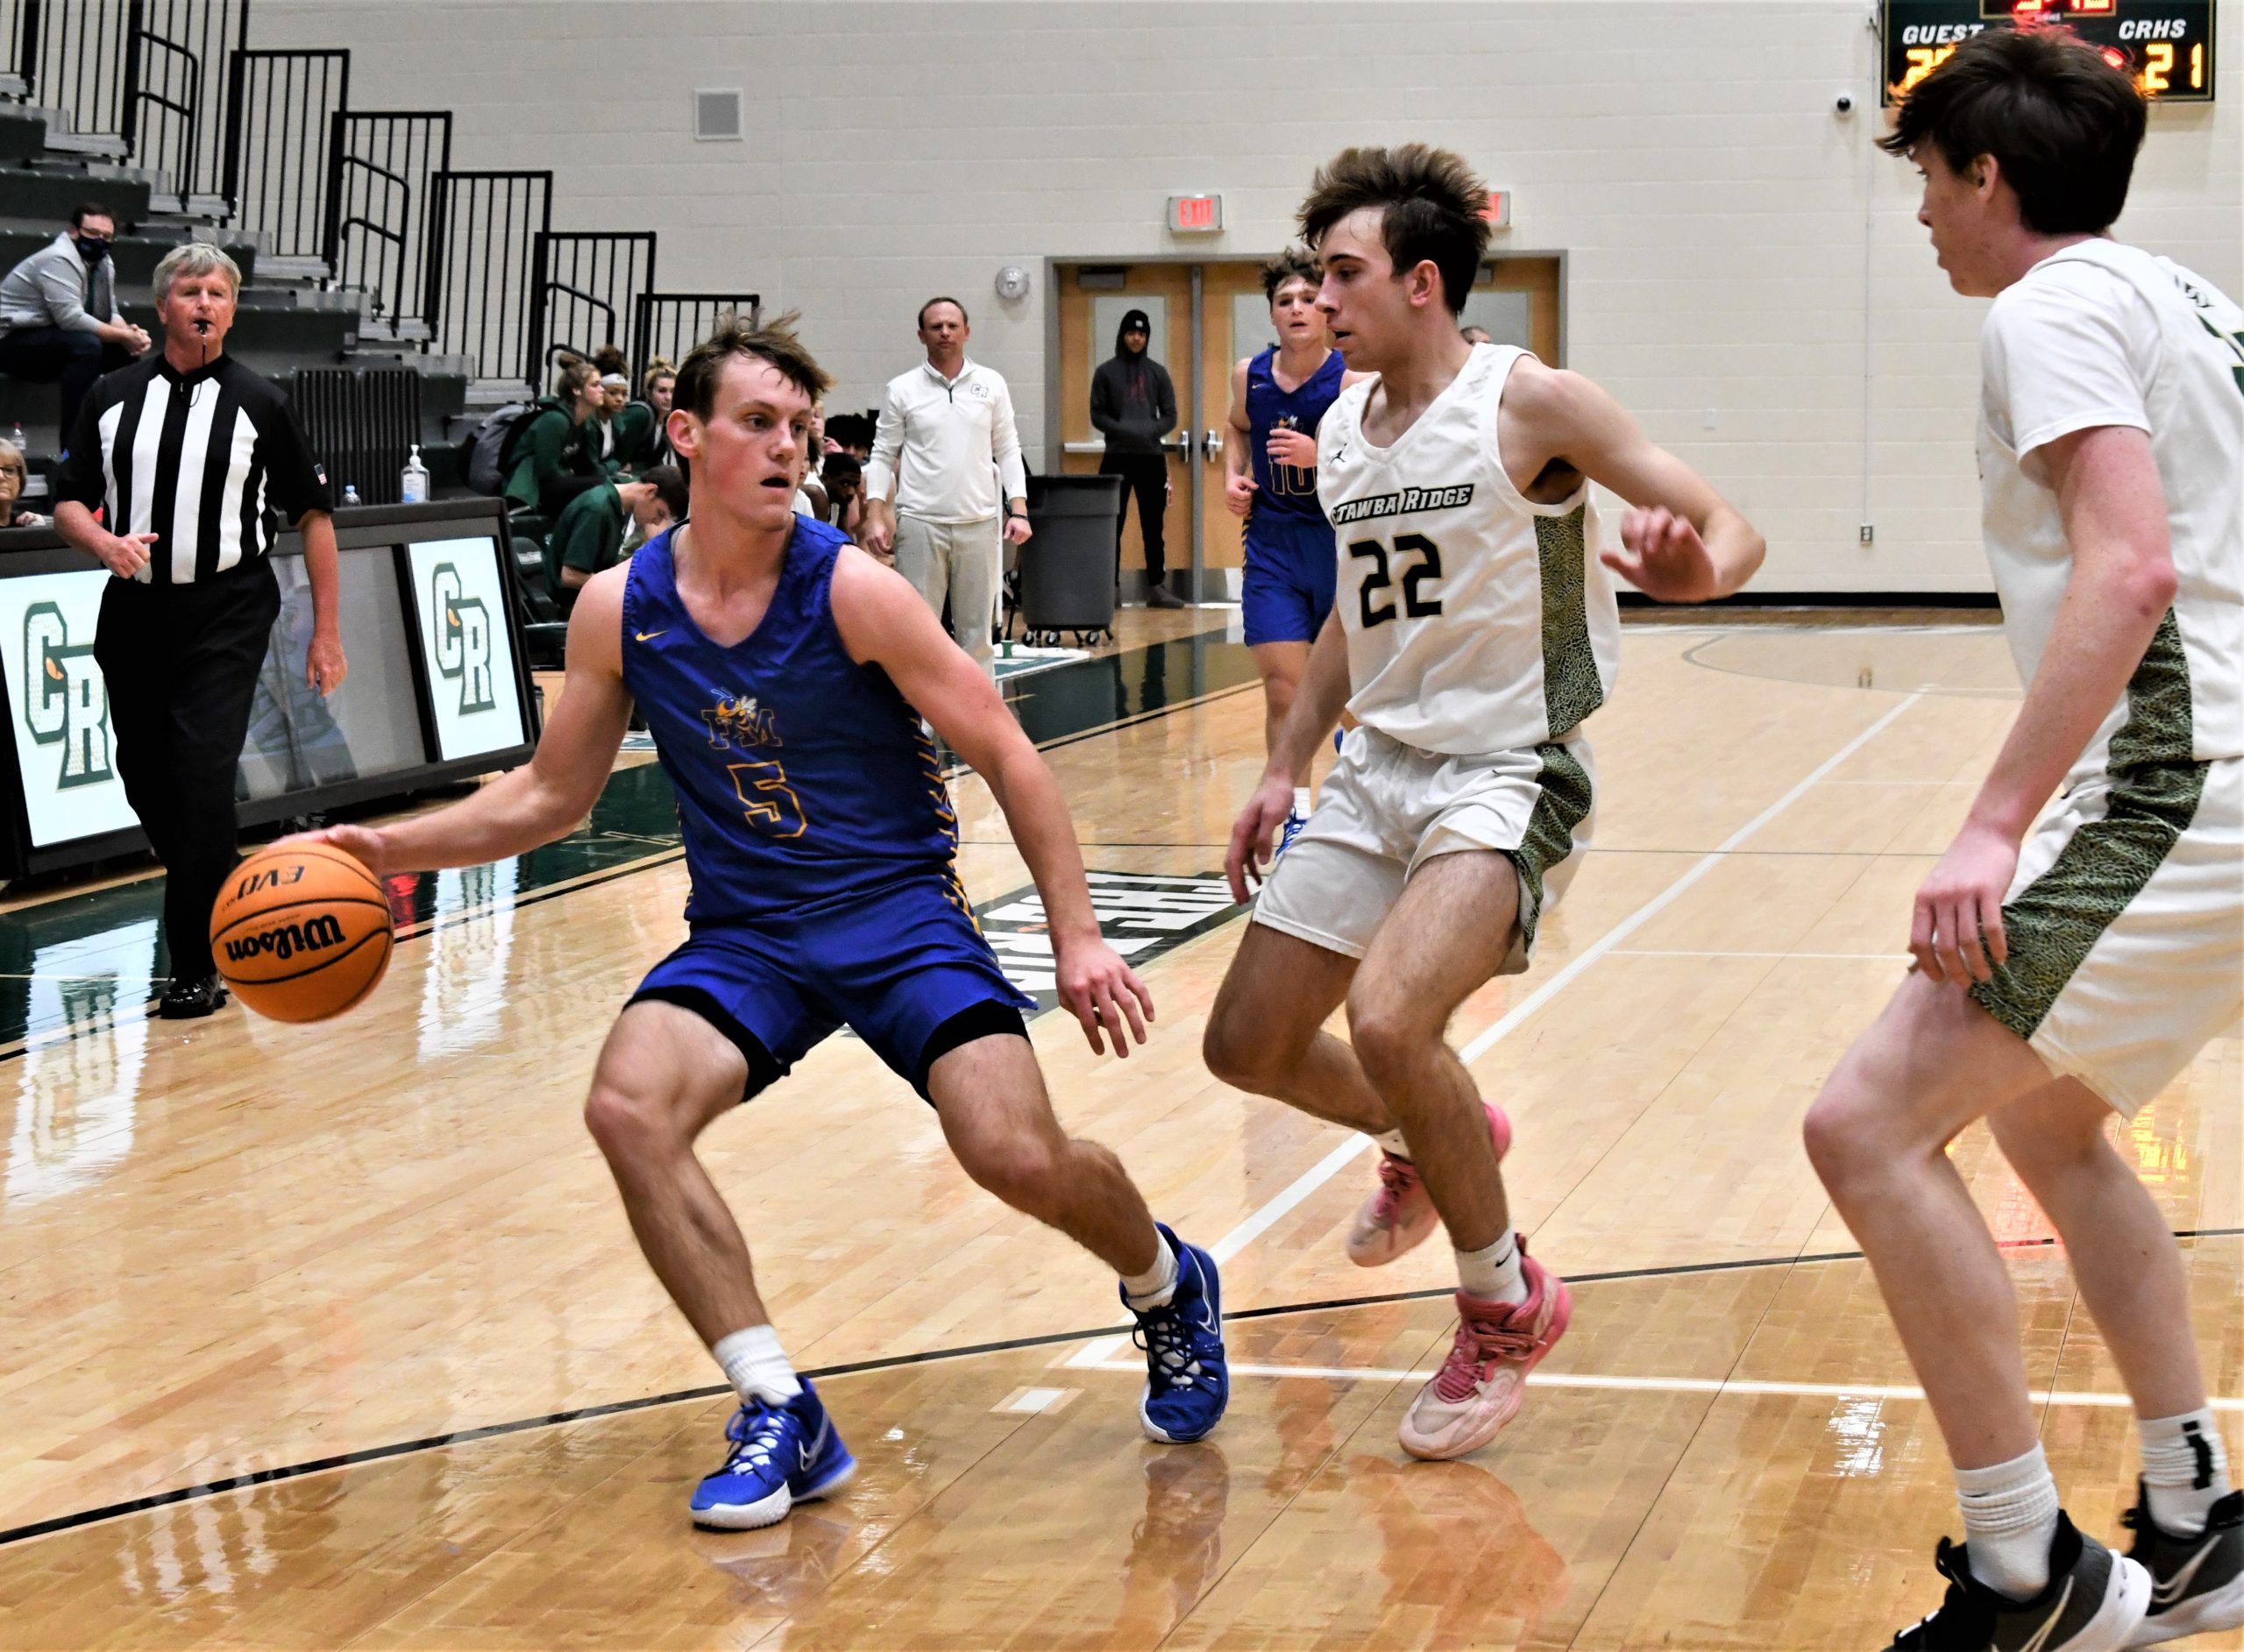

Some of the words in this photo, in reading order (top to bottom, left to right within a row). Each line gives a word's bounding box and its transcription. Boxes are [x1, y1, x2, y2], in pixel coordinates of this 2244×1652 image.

[1902, 24, 1984, 45] GUEST
[2118, 18, 2187, 39] CRHS
[2144, 42, 2203, 89] 21
[1178, 198, 1213, 227] EXIT
[970, 383, 989, 398] CR
[1400, 484, 1474, 514] RIDGE
[1349, 532, 1443, 630] 22
[431, 561, 497, 717] CR
[24, 599, 114, 792] CR
[727, 760, 808, 839] 5
[237, 865, 306, 900] EVO
[224, 914, 347, 963] Wilson
